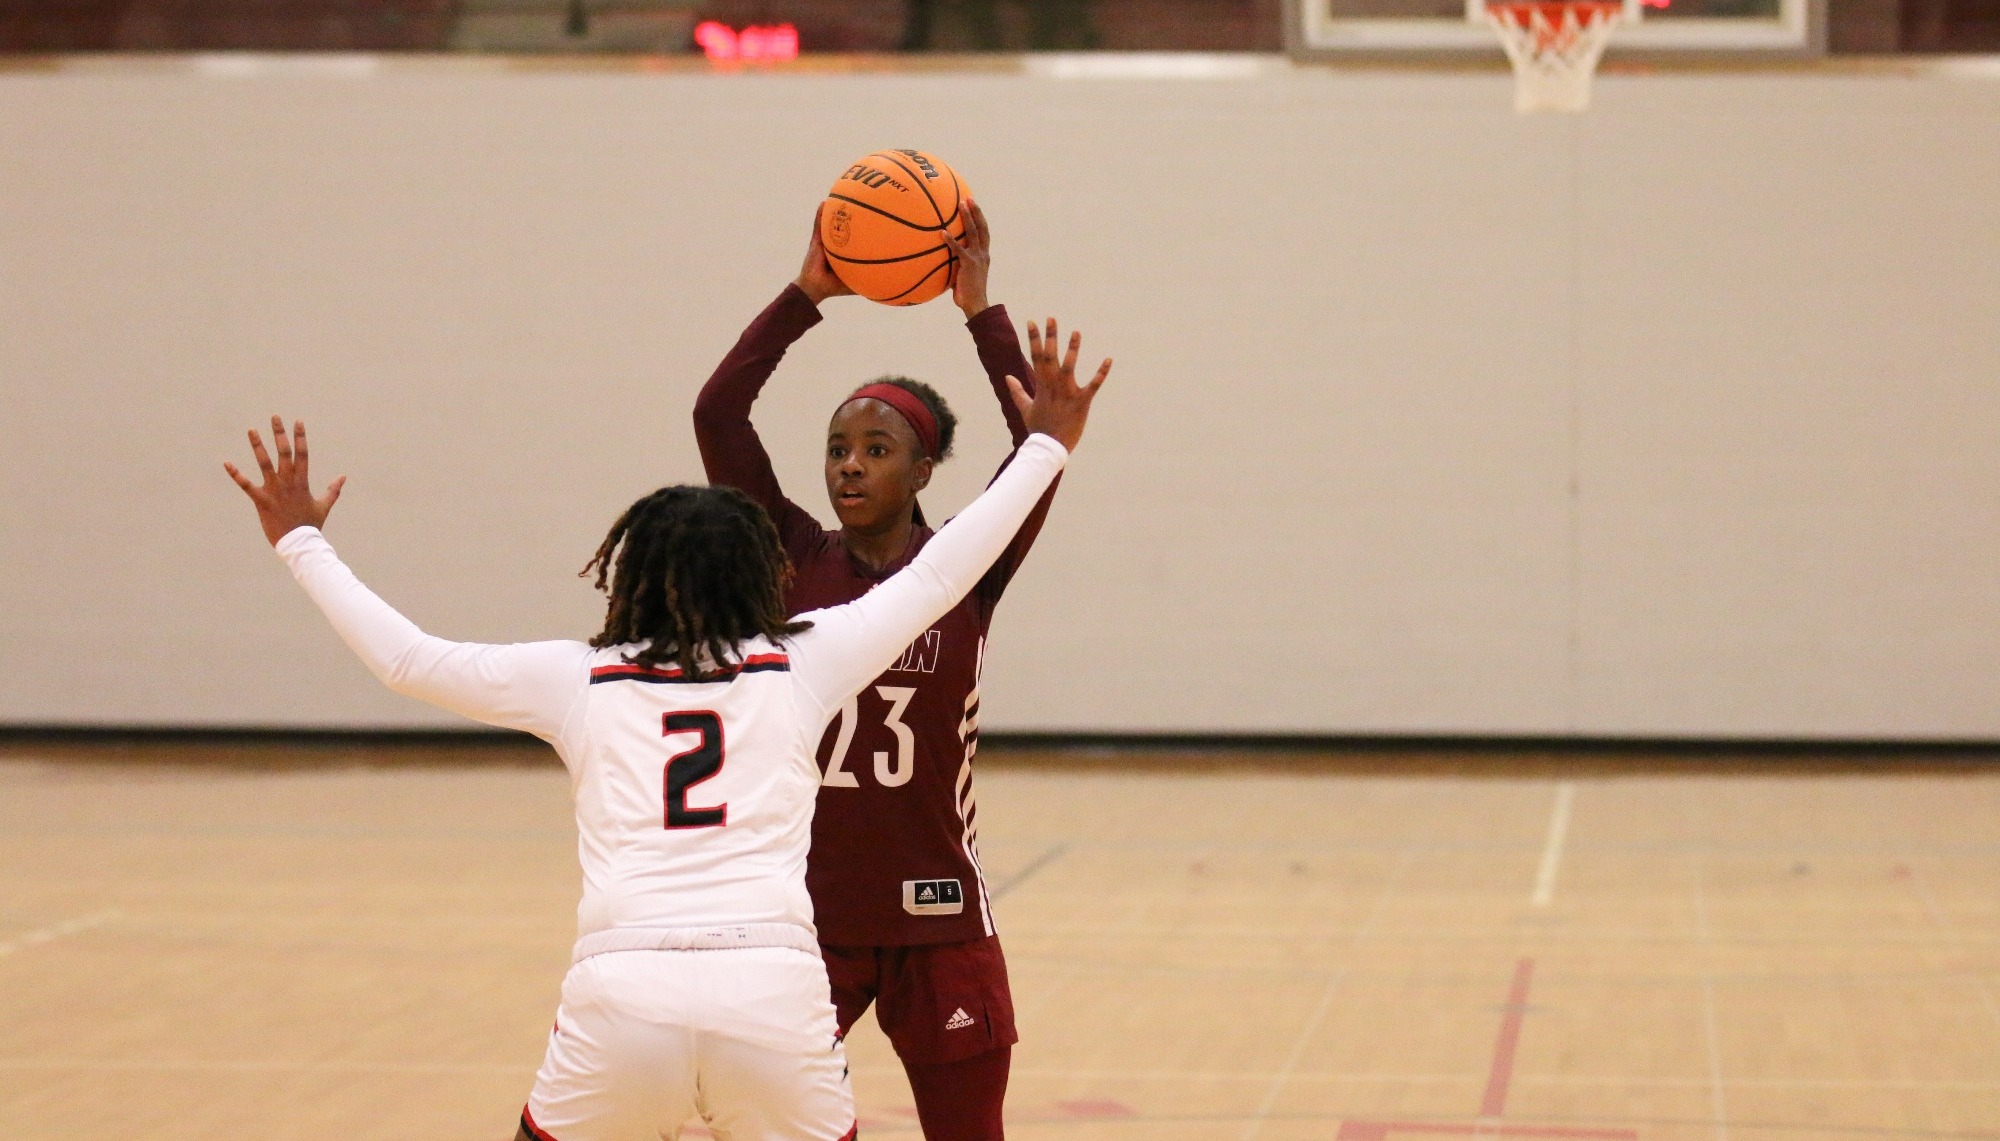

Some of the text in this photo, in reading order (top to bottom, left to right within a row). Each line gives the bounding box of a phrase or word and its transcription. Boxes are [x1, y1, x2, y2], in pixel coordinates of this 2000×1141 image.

[841, 165, 909, 193] EVO NXT
[822, 685, 915, 788] 23
[662, 709, 727, 830] 2
[945, 1017, 975, 1030] adidas
